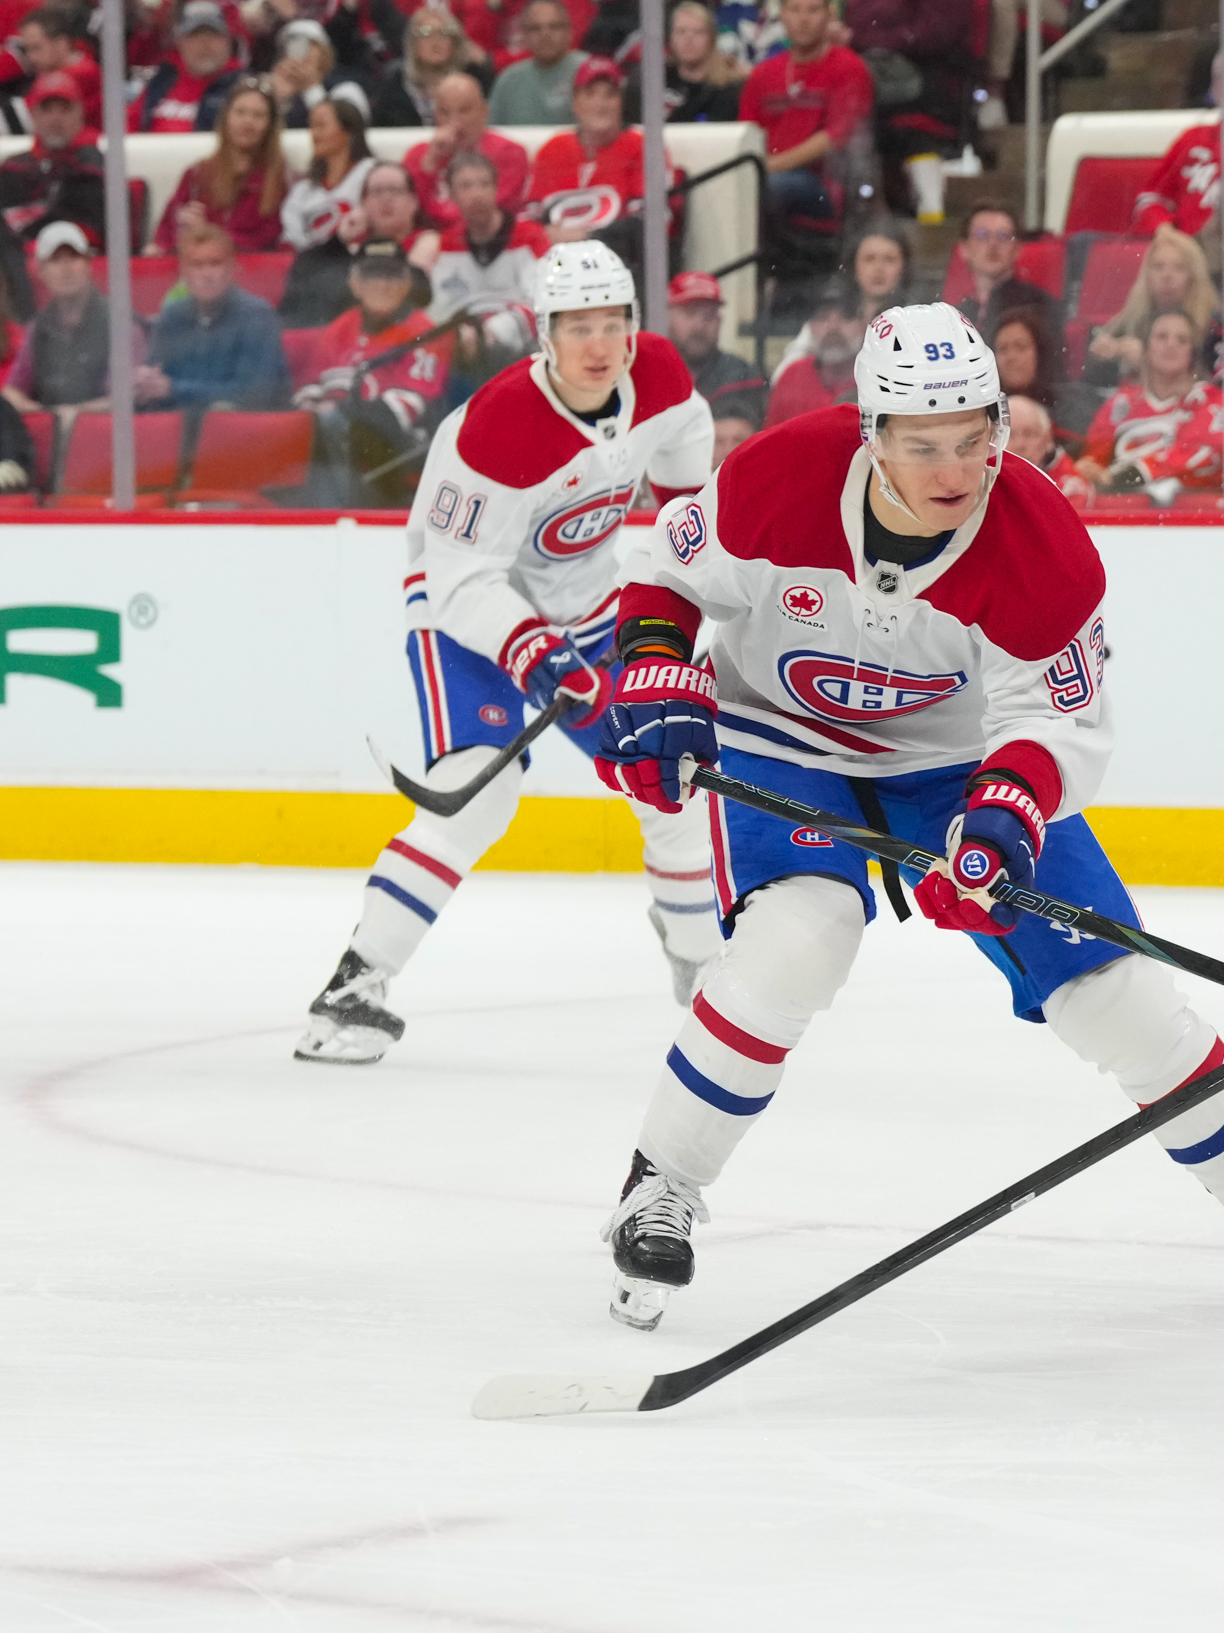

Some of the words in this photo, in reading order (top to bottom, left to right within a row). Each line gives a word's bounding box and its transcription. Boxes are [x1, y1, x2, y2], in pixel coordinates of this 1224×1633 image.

[924, 342, 956, 361] 93
[923, 379, 968, 390] BAUER
[427, 480, 487, 544] 91
[788, 615, 825, 630] CANADA
